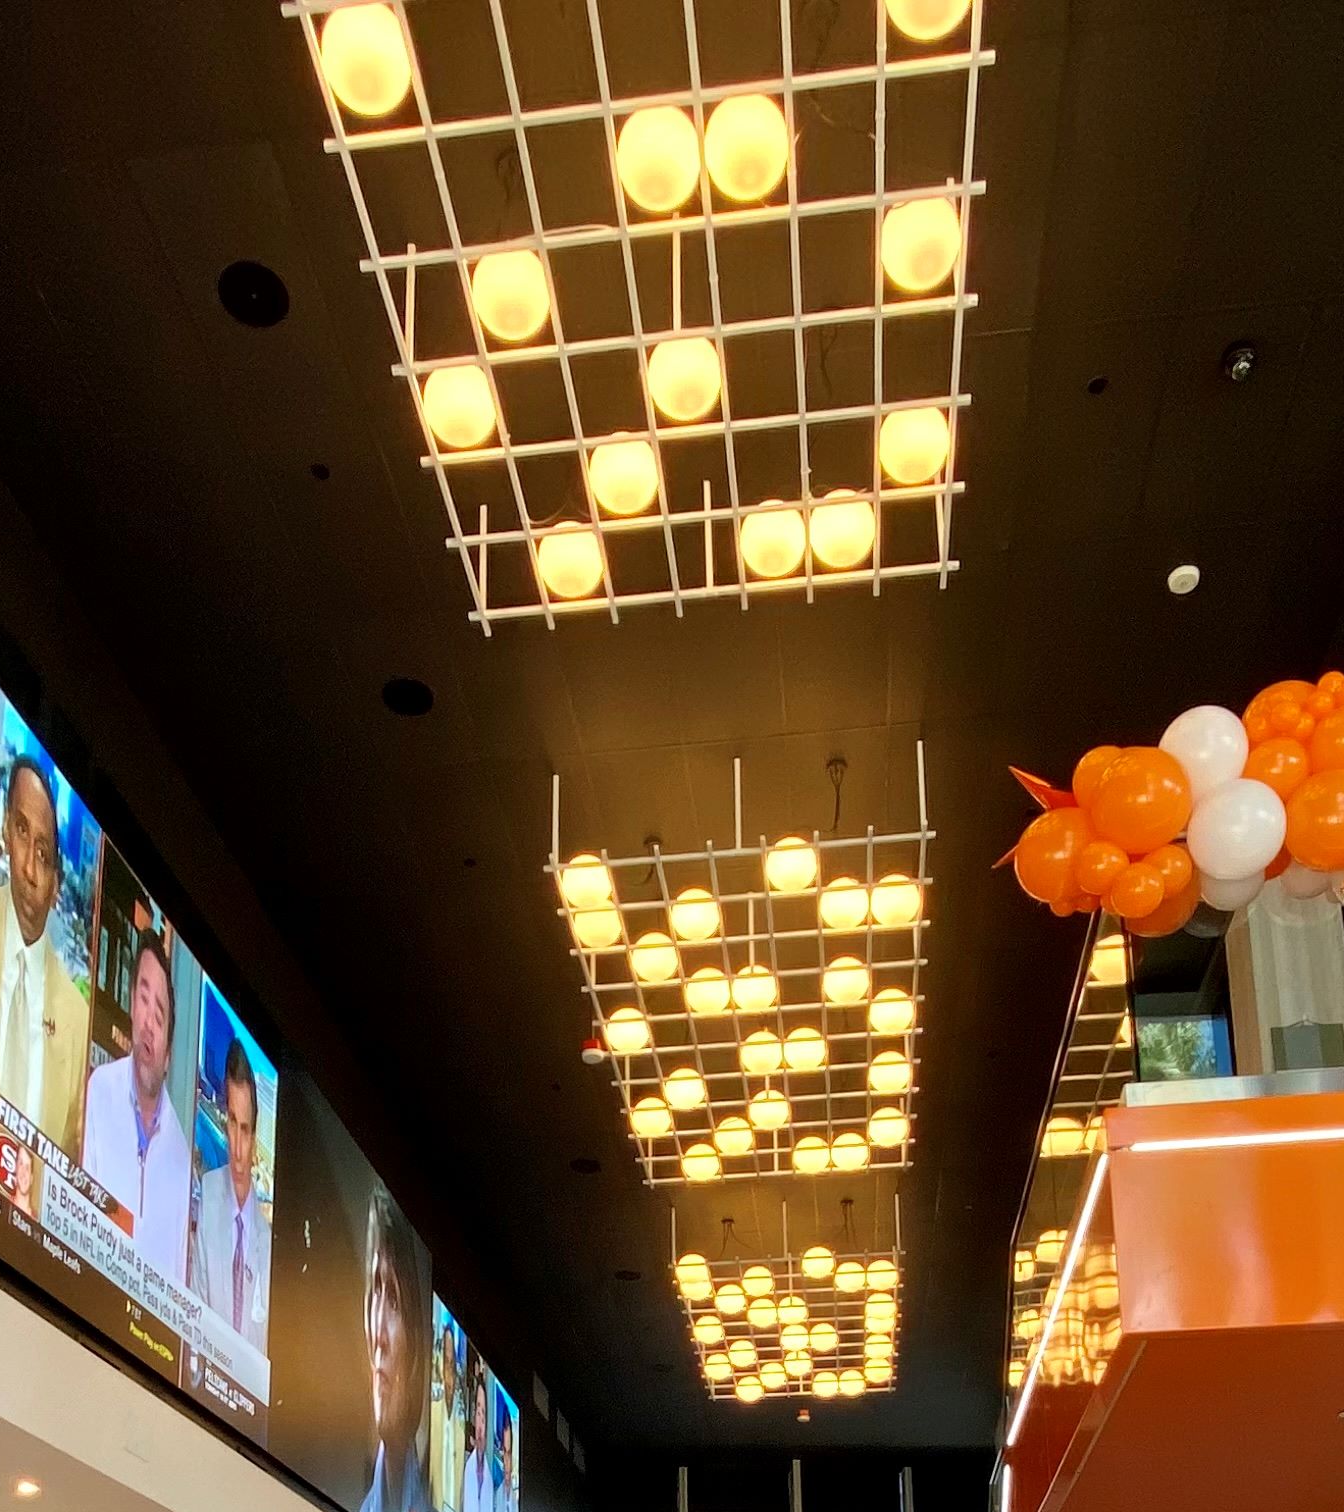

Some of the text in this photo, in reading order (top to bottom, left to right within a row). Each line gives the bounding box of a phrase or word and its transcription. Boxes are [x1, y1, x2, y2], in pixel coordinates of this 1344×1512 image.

[36, 1131, 70, 1179] TAKE
[11, 1209, 32, 1237] Stars
[42, 1233, 63, 1262] Maple
[46, 1203, 63, 1234] Top
[62, 1215, 70, 1236] 5
[79, 1231, 96, 1260] NFL
[47, 1174, 203, 1323] Is Brock Purdy just a game manager?
